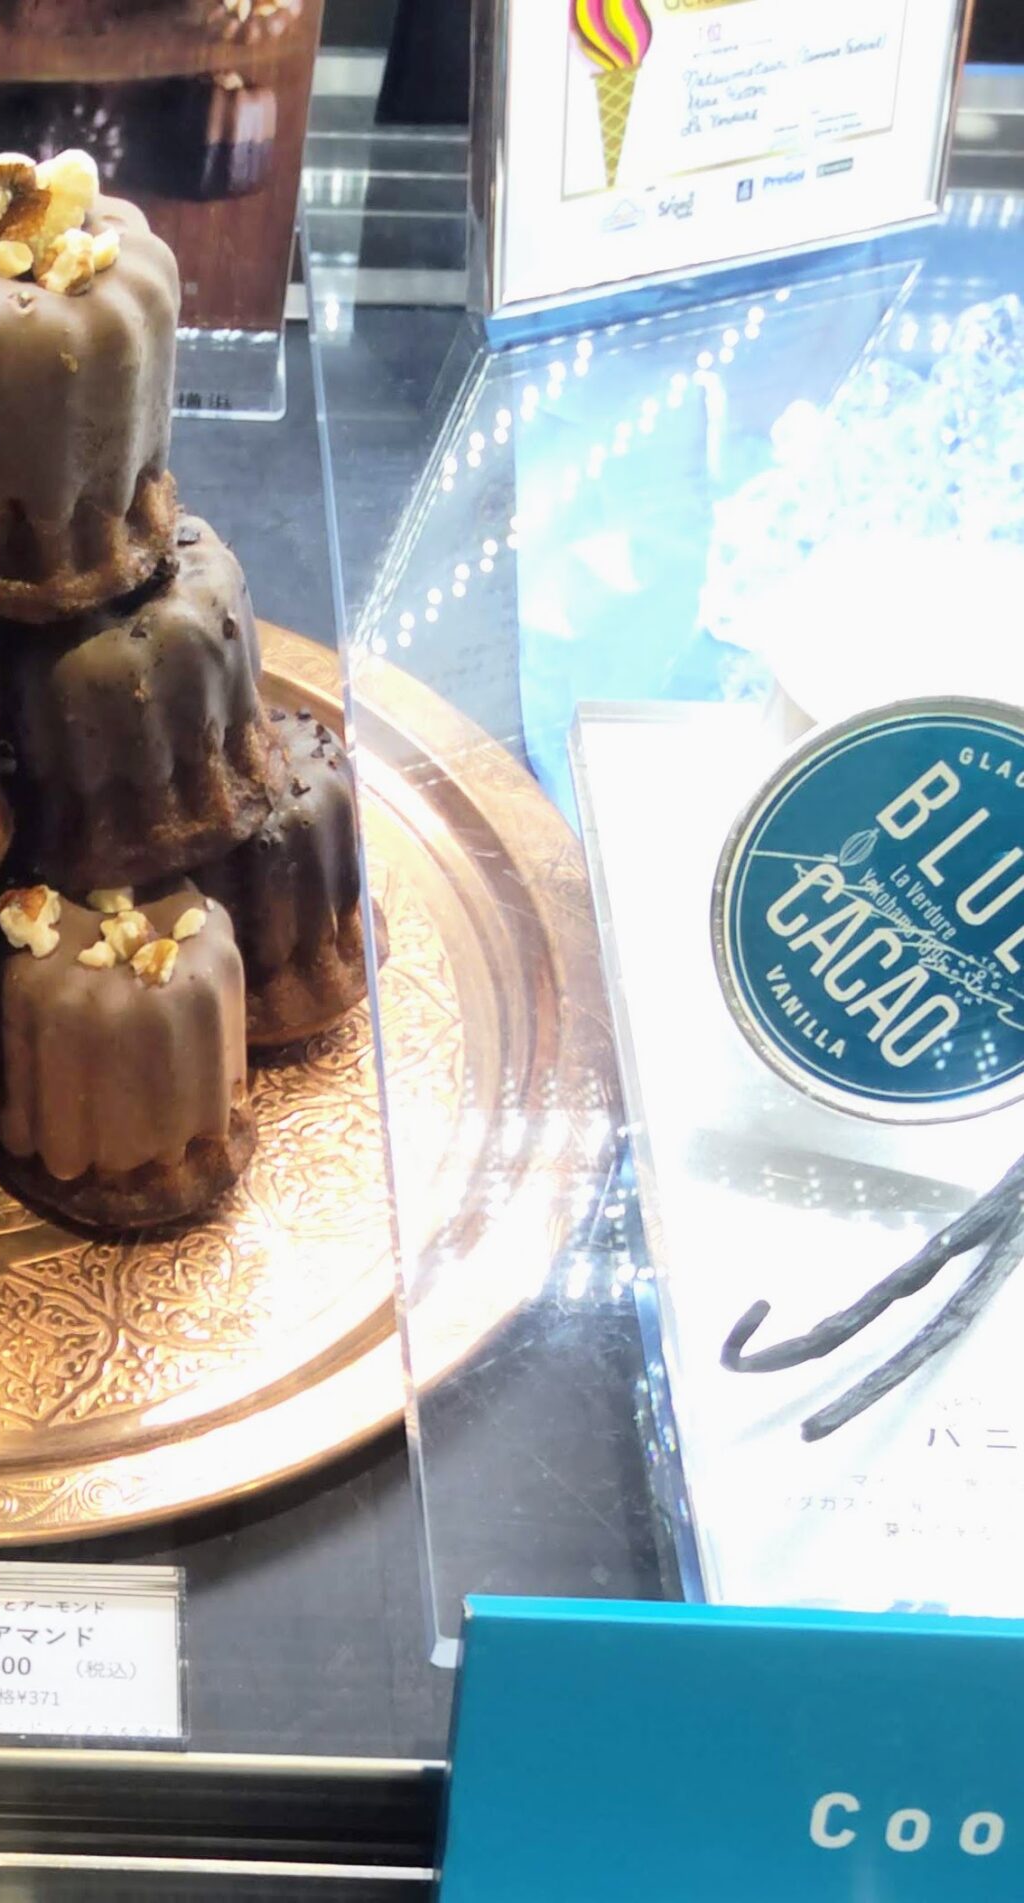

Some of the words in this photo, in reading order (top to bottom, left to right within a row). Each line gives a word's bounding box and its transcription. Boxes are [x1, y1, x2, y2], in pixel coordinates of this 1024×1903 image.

[889, 864, 911, 889] La
[906, 881, 957, 941] Verdure
[766, 862, 960, 1068] CACAO
[765, 963, 847, 1061] VANILLA
[810, 1792, 1005, 1856] Coo
